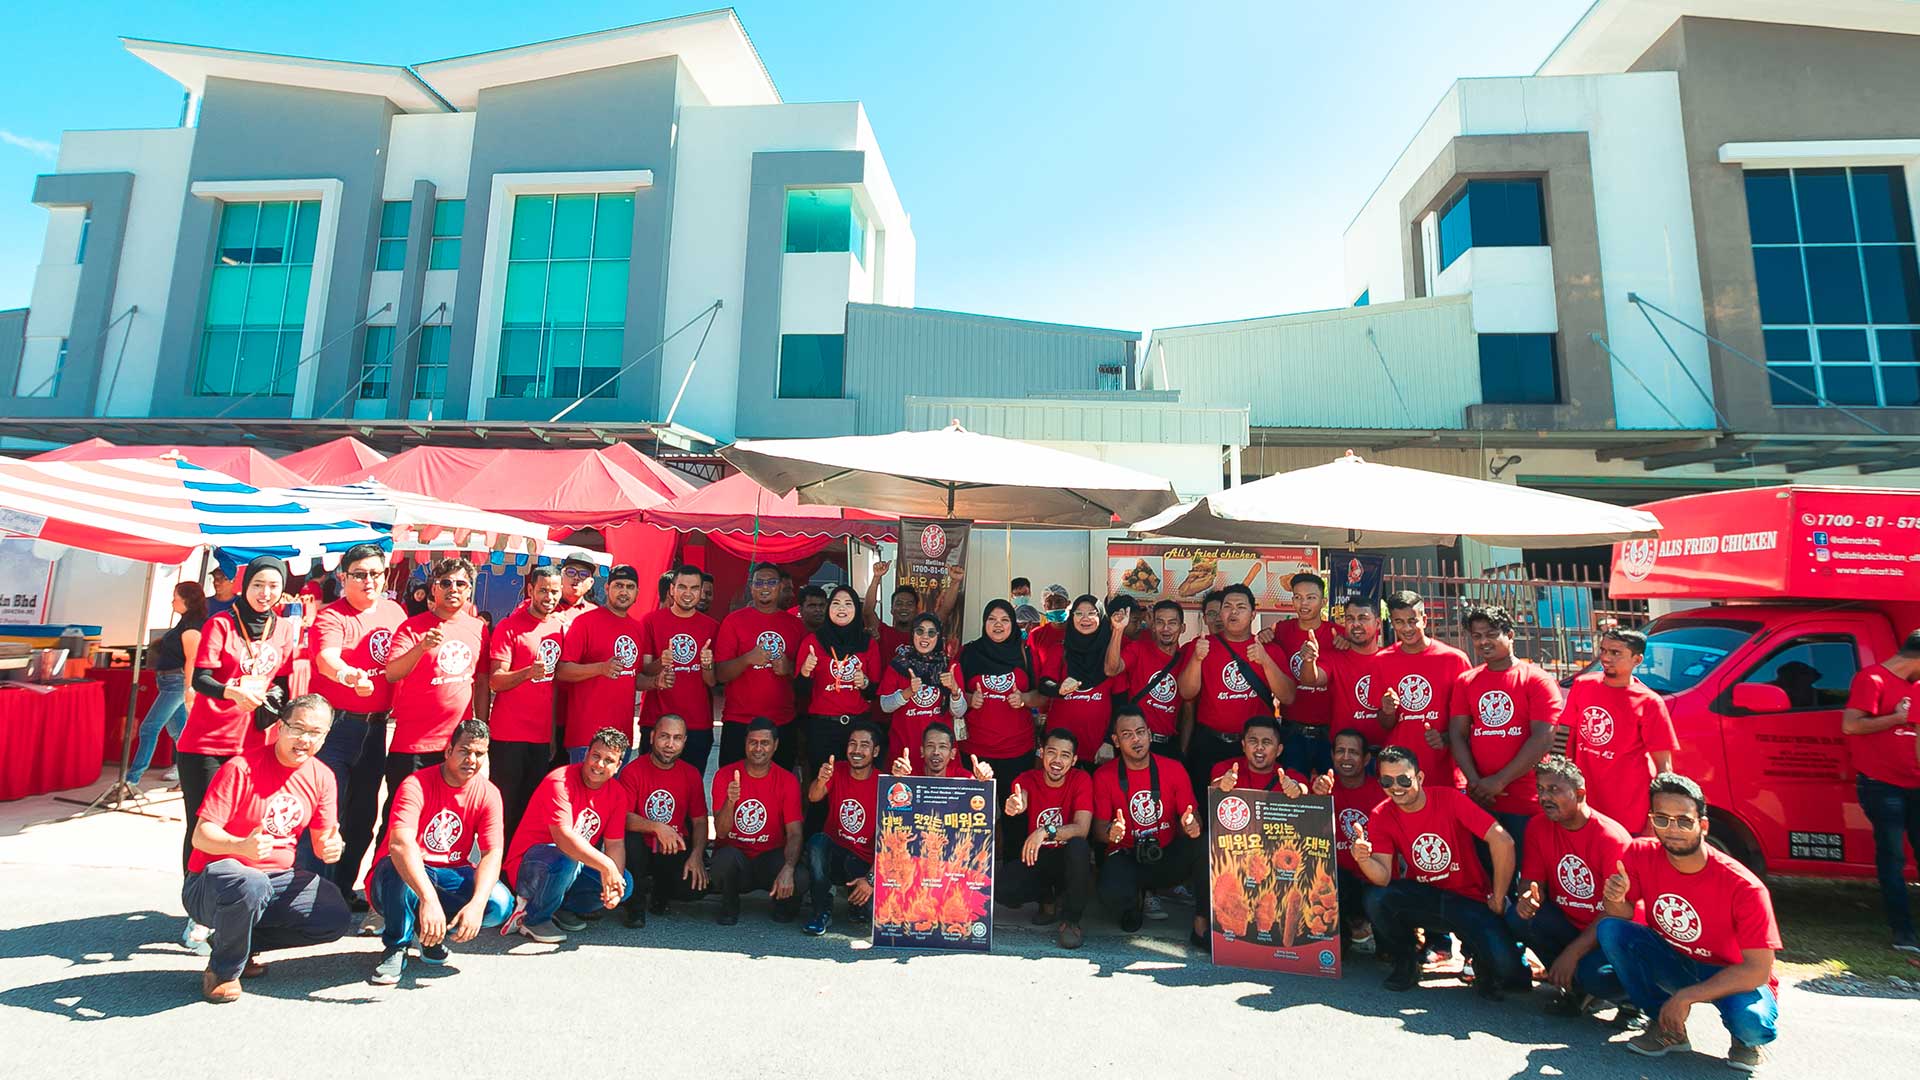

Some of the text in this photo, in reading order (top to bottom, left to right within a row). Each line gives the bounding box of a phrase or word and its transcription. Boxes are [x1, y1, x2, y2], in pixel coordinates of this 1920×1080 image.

[1818, 514, 1854, 526] 1700
[1865, 515, 1884, 527] 81
[1658, 531, 1778, 557] ALIS FRIED CHICKEN
[1192, 548, 1219, 560] fried
[1220, 549, 1257, 560] chicken
[13, 594, 37, 607] Bhd
[944, 812, 987, 829] 매워요
[1263, 823, 1295, 835] 맛있는
[1218, 833, 1330, 852] 매워요 대박
[1656, 897, 1697, 920] ALIS
